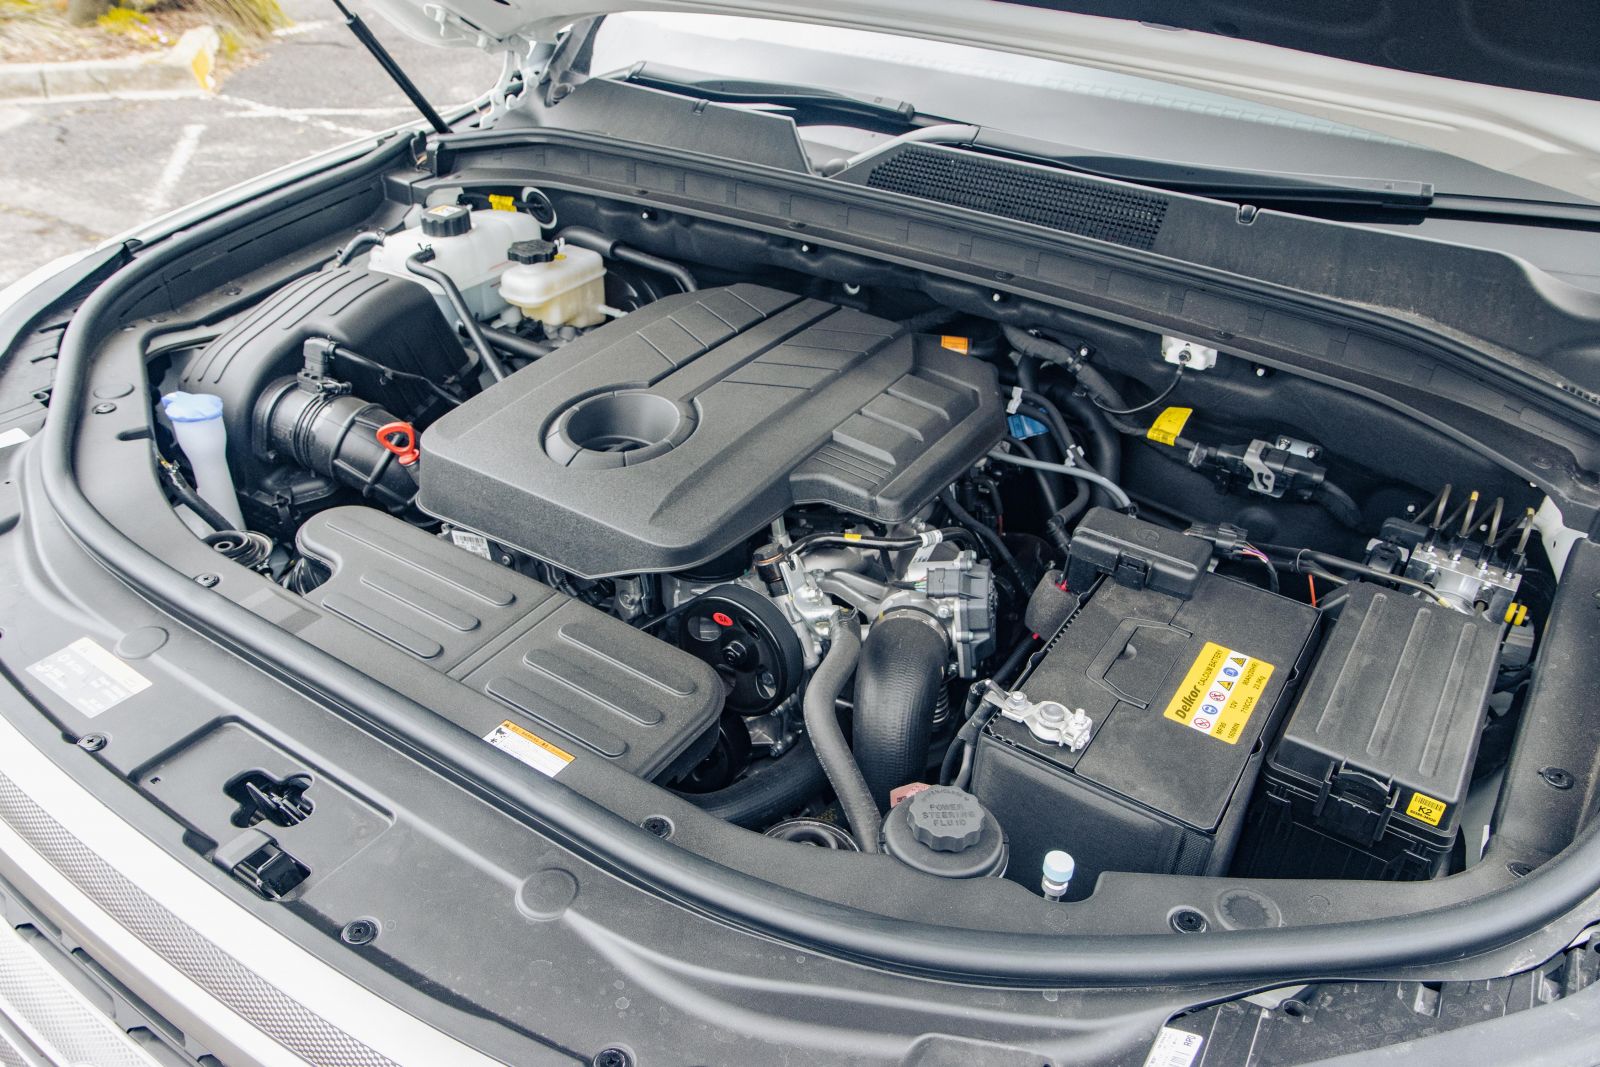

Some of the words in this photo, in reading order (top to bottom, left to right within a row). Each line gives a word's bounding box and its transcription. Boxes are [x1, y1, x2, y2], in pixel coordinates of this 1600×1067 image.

[1175, 685, 1202, 719] Delkor
[1208, 649, 1223, 668] BATTERY
[930, 803, 964, 811] POWER
[1418, 805, 1433, 817] K2
[922, 811, 976, 819] STEERING
[933, 819, 967, 827] FLUID
